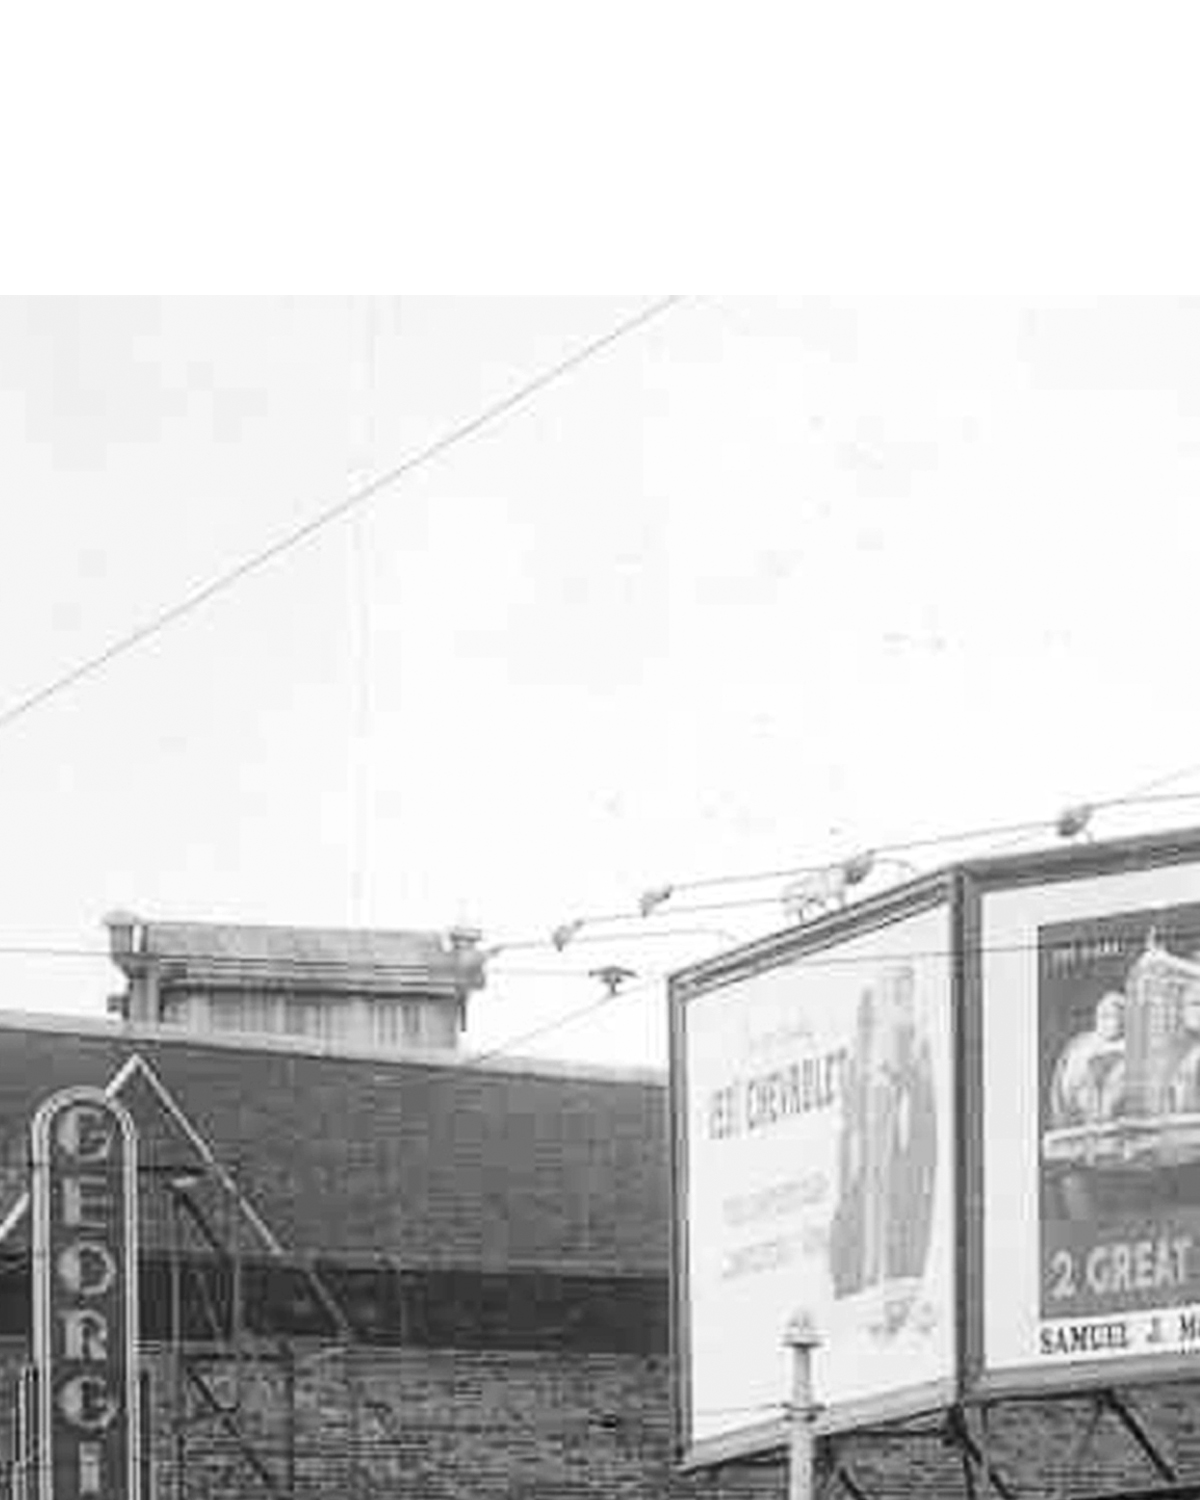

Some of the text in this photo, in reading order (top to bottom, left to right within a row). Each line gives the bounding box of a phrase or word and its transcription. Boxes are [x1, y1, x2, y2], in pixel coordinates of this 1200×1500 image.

[1051, 1236, 1193, 1299] 2 GREAT
[1040, 1323, 1126, 1355] SAMUEL
[1177, 1311, 1200, 1344] M
